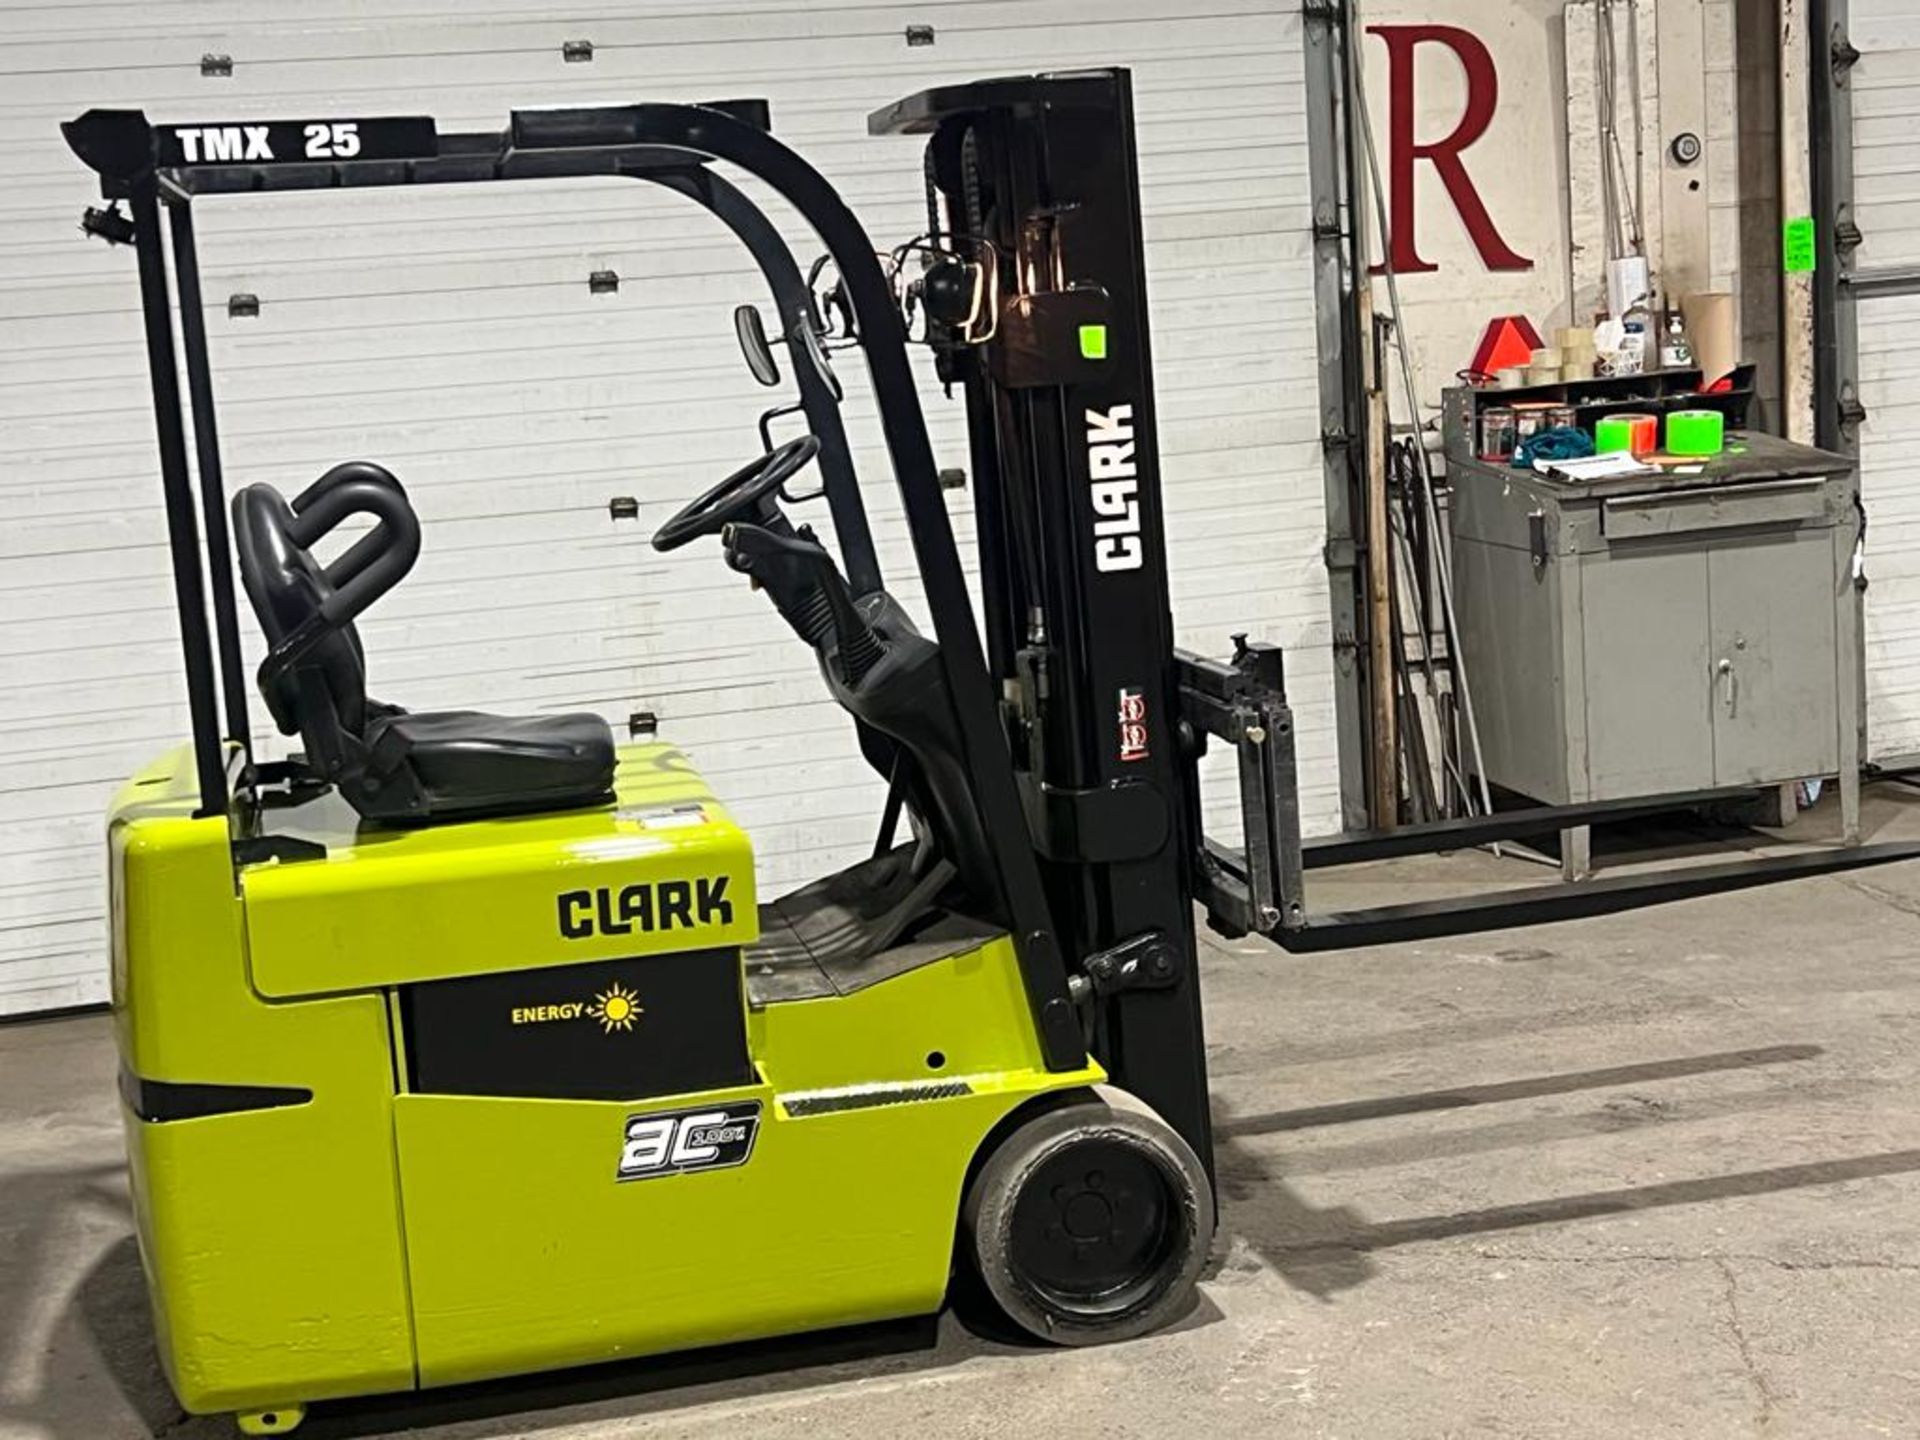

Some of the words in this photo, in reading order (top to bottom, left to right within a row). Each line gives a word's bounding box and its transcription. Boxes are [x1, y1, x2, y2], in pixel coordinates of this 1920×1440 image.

[175, 126, 275, 162] TMX
[303, 123, 360, 158] 25
[1365, 24, 1534, 276] R
[1085, 404, 1143, 572] CLARK
[557, 876, 734, 939] CLARK
